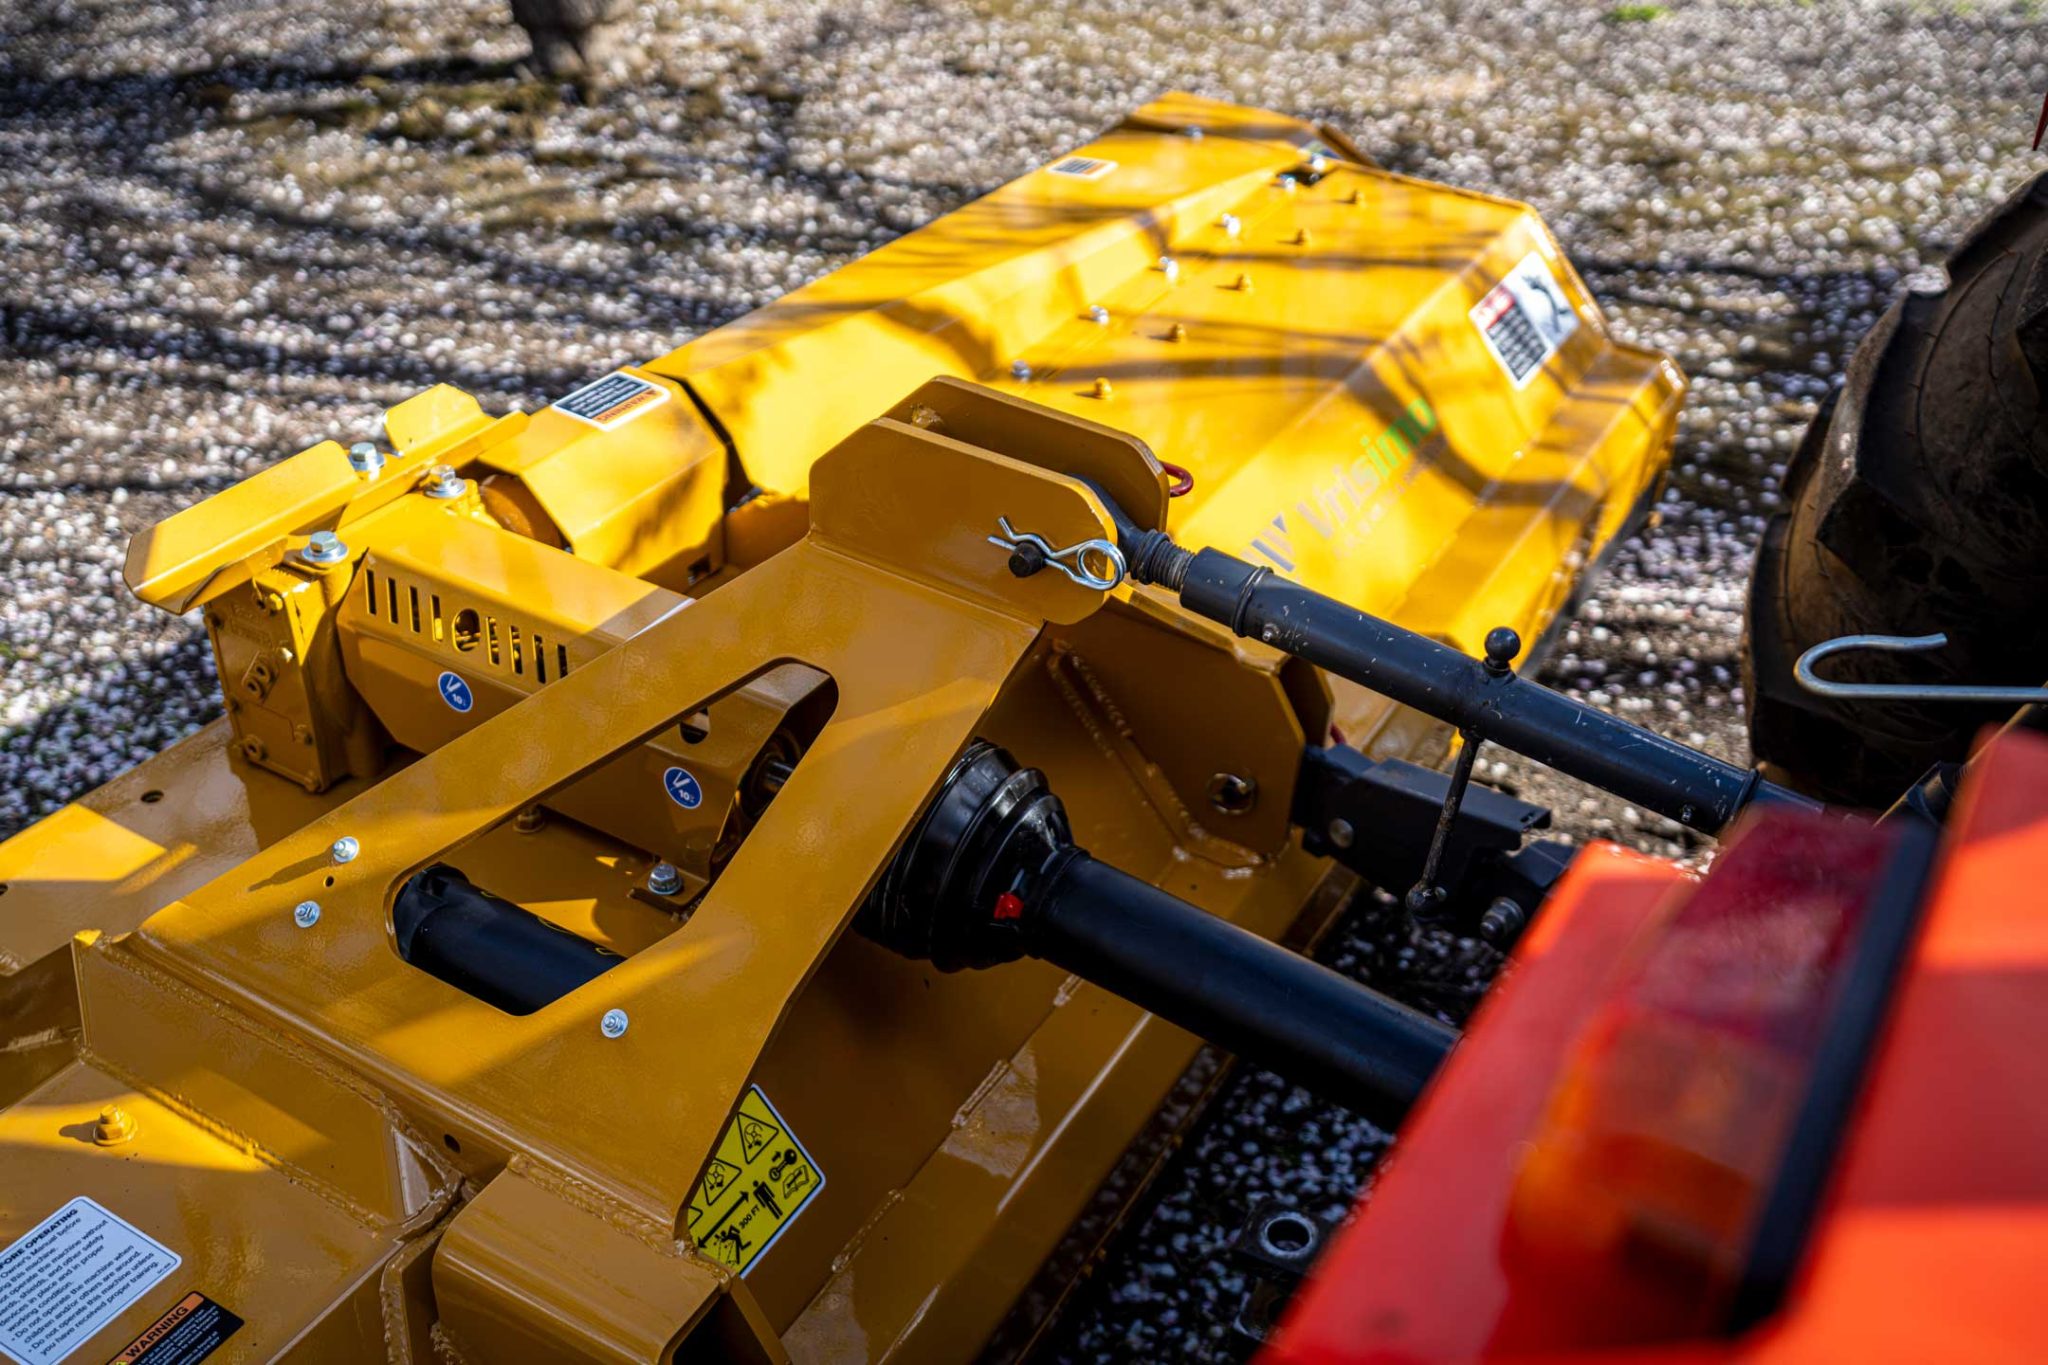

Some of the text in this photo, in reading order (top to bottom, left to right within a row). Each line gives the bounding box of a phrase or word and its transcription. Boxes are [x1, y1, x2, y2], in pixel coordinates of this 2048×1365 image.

[25, 1209, 78, 1248] OPERATING
[29, 1234, 57, 1256] Manual
[56, 1217, 81, 1236] before
[739, 1204, 760, 1229] 300 FT
[9, 1272, 38, 1295] operate
[37, 1263, 51, 1273] the
[51, 1239, 82, 1263] machine
[81, 1219, 108, 1240] without
[9, 1271, 26, 1283] this
[27, 1296, 37, 1304] in
[36, 1280, 58, 1298] place
[58, 1268, 73, 1282] and
[80, 1244, 104, 1265] proper
[47, 1264, 63, 1278] and
[62, 1250, 82, 1266] other
[82, 1234, 104, 1251] safety
[14, 1245, 134, 1338] Do not operate the machine when
[24, 1319, 54, 1343] children
[79, 1281, 103, 1300] others
[102, 1271, 115, 1282] are
[30, 1338, 45, 1350] Do
[44, 1327, 59, 1339] not
[58, 1305, 87, 1329] operate
[86, 1294, 102, 1306] this
[101, 1270, 131, 1295] machine
[131, 1252, 154, 1271] unless
[7, 1308, 39, 1332] working
[40, 1342, 56, 1356] you
[54, 1327, 75, 1343] have
[74, 1301, 107, 1328] received
[106, 1282, 130, 1303] proper
[125, 1306, 188, 1357] WARNING
